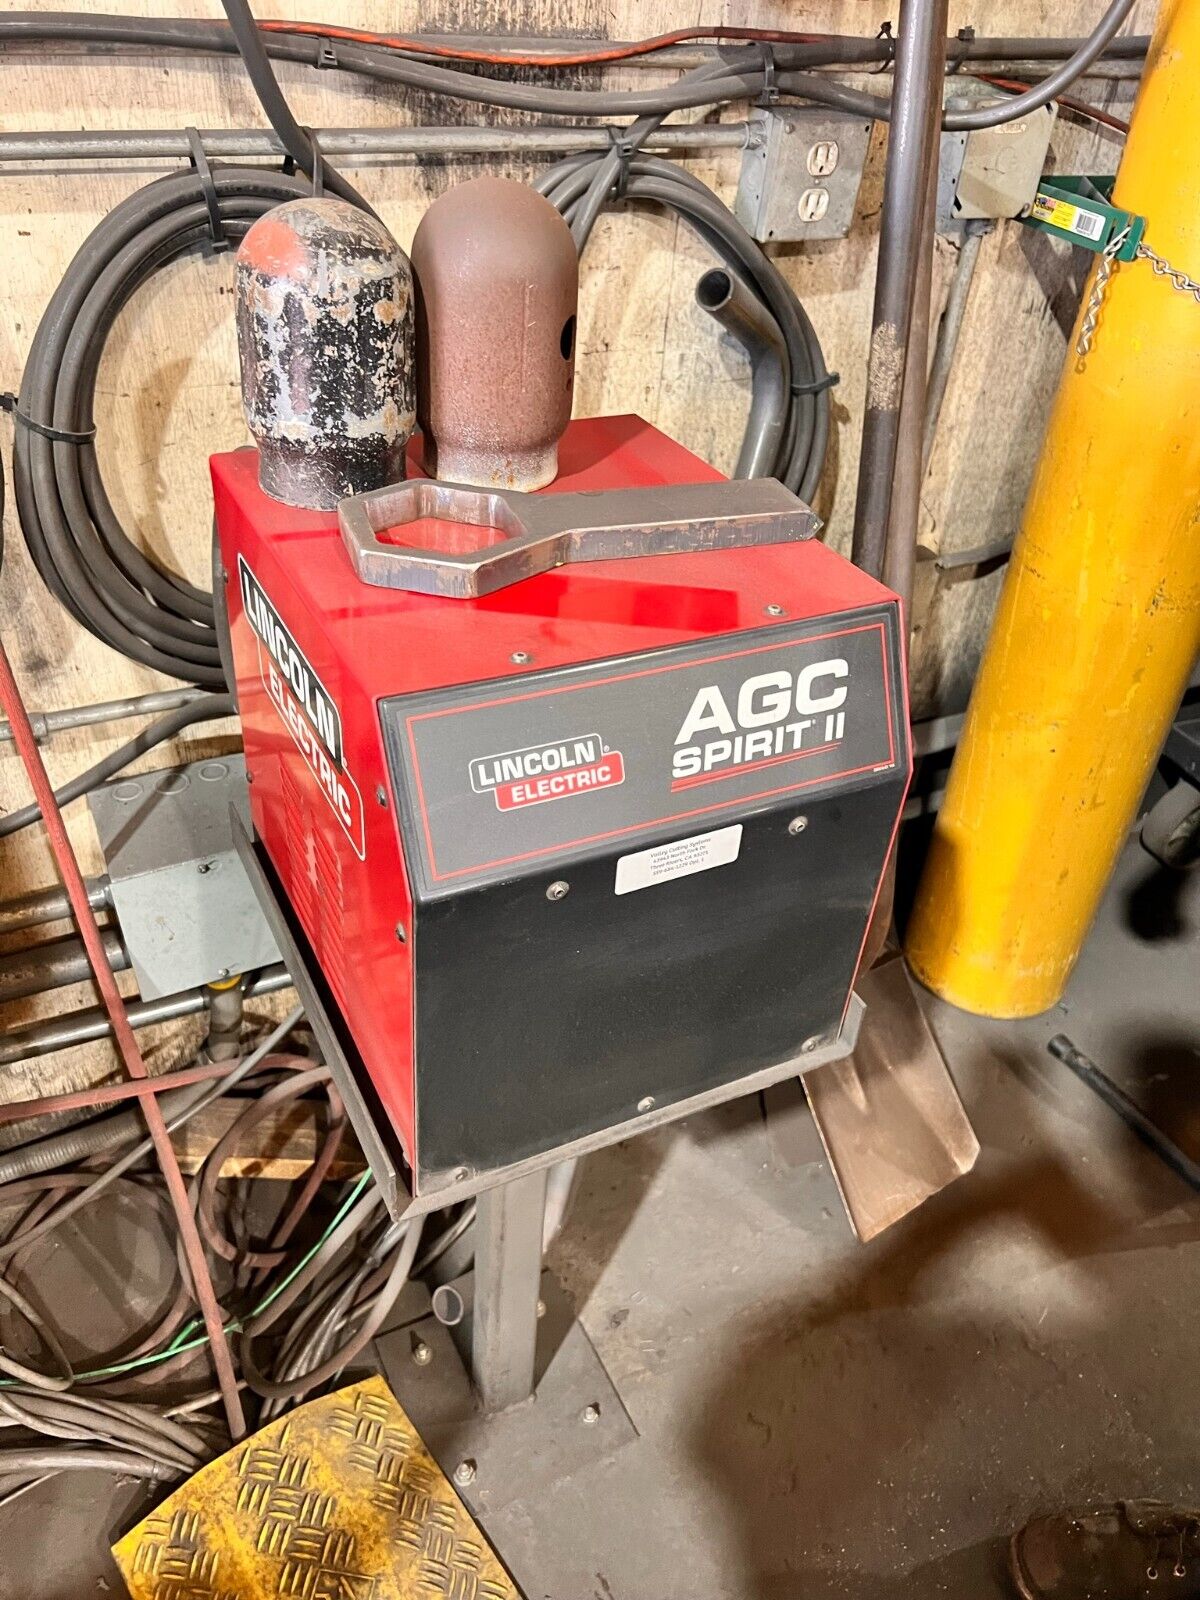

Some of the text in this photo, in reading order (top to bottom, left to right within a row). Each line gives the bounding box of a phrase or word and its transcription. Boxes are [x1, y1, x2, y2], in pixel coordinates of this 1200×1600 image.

[243, 571, 337, 759] LINCOLN
[673, 658, 849, 746] AGC
[268, 661, 352, 828] ELECTRIC
[478, 738, 596, 787] LINCOLN
[672, 712, 846, 779] SPIRIT II
[510, 765, 612, 803] ELECTRIC
[669, 844, 688, 854] Cutting
[689, 838, 711, 848] Systems
